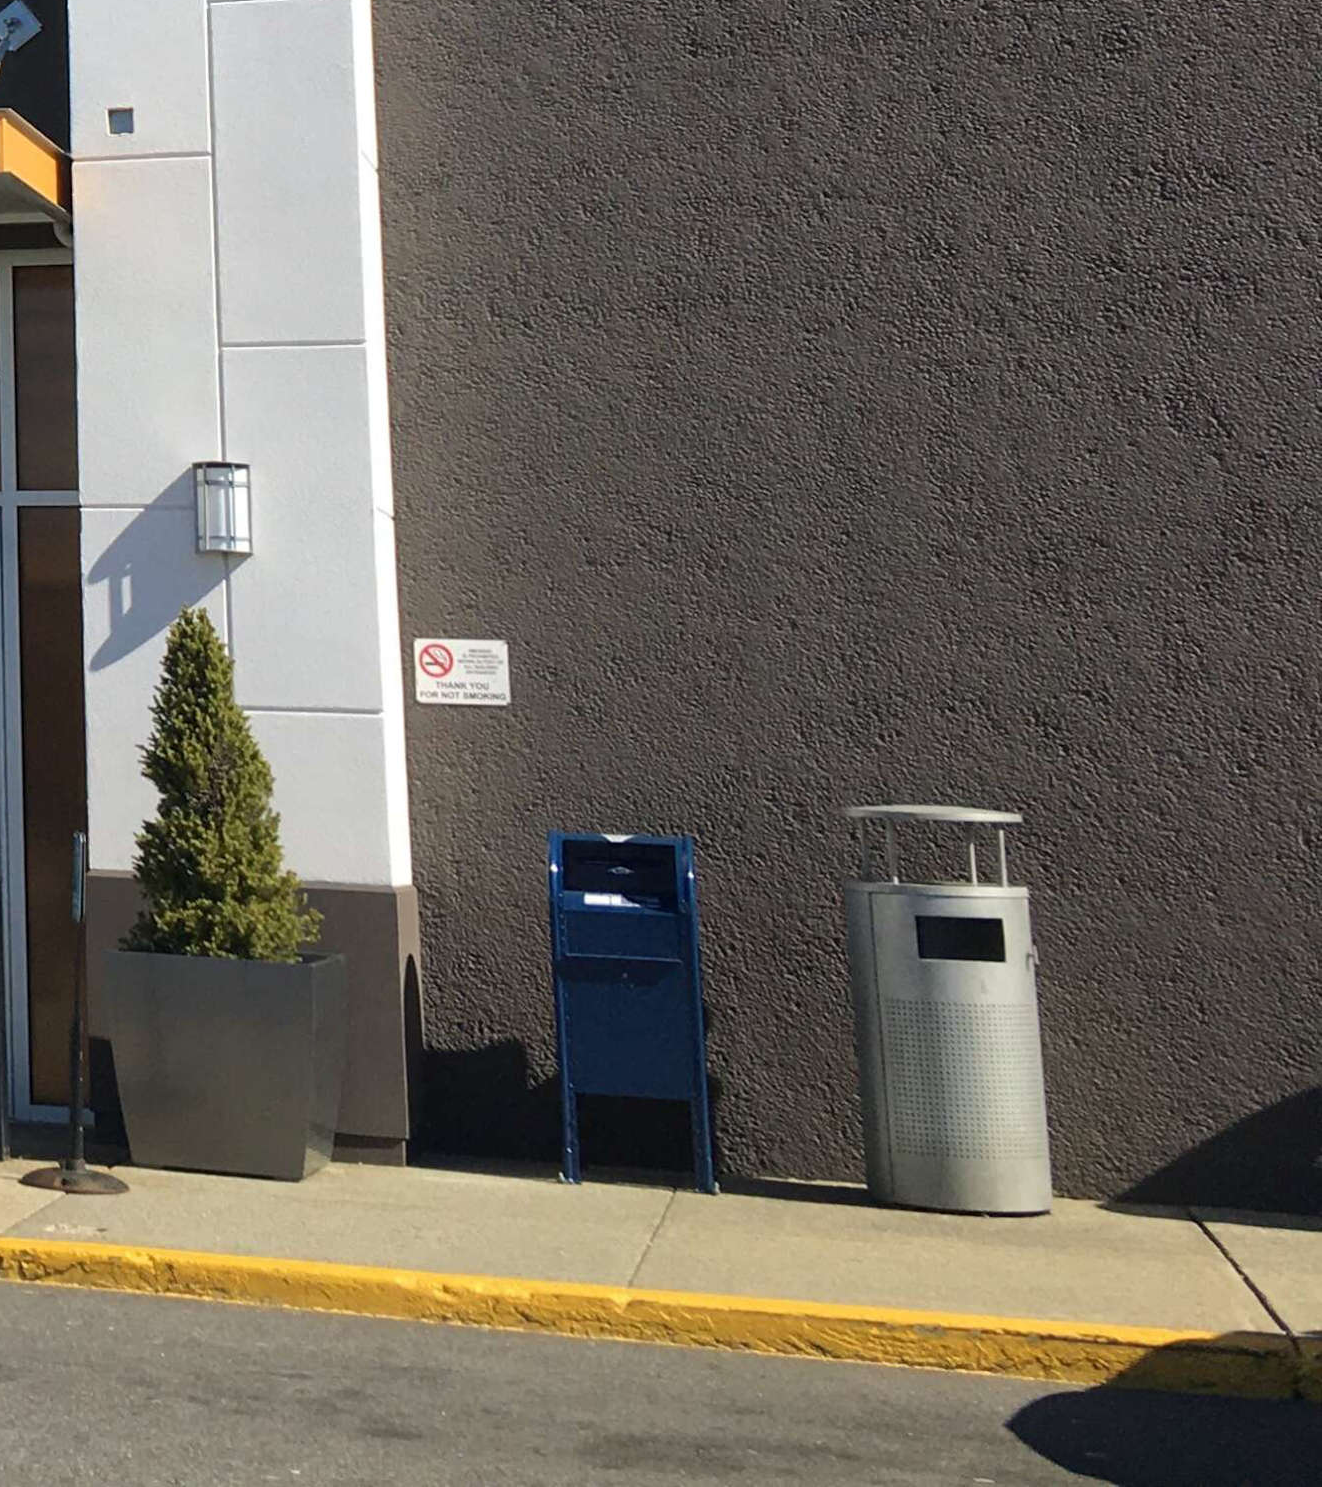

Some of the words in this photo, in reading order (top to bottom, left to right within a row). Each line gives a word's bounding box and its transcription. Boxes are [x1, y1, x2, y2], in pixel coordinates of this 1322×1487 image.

[436, 681, 467, 690] THANK
[469, 682, 489, 690] YOU
[420, 691, 438, 699] FOR
[441, 691, 460, 699] NOT
[463, 692, 507, 701] SMOKING
